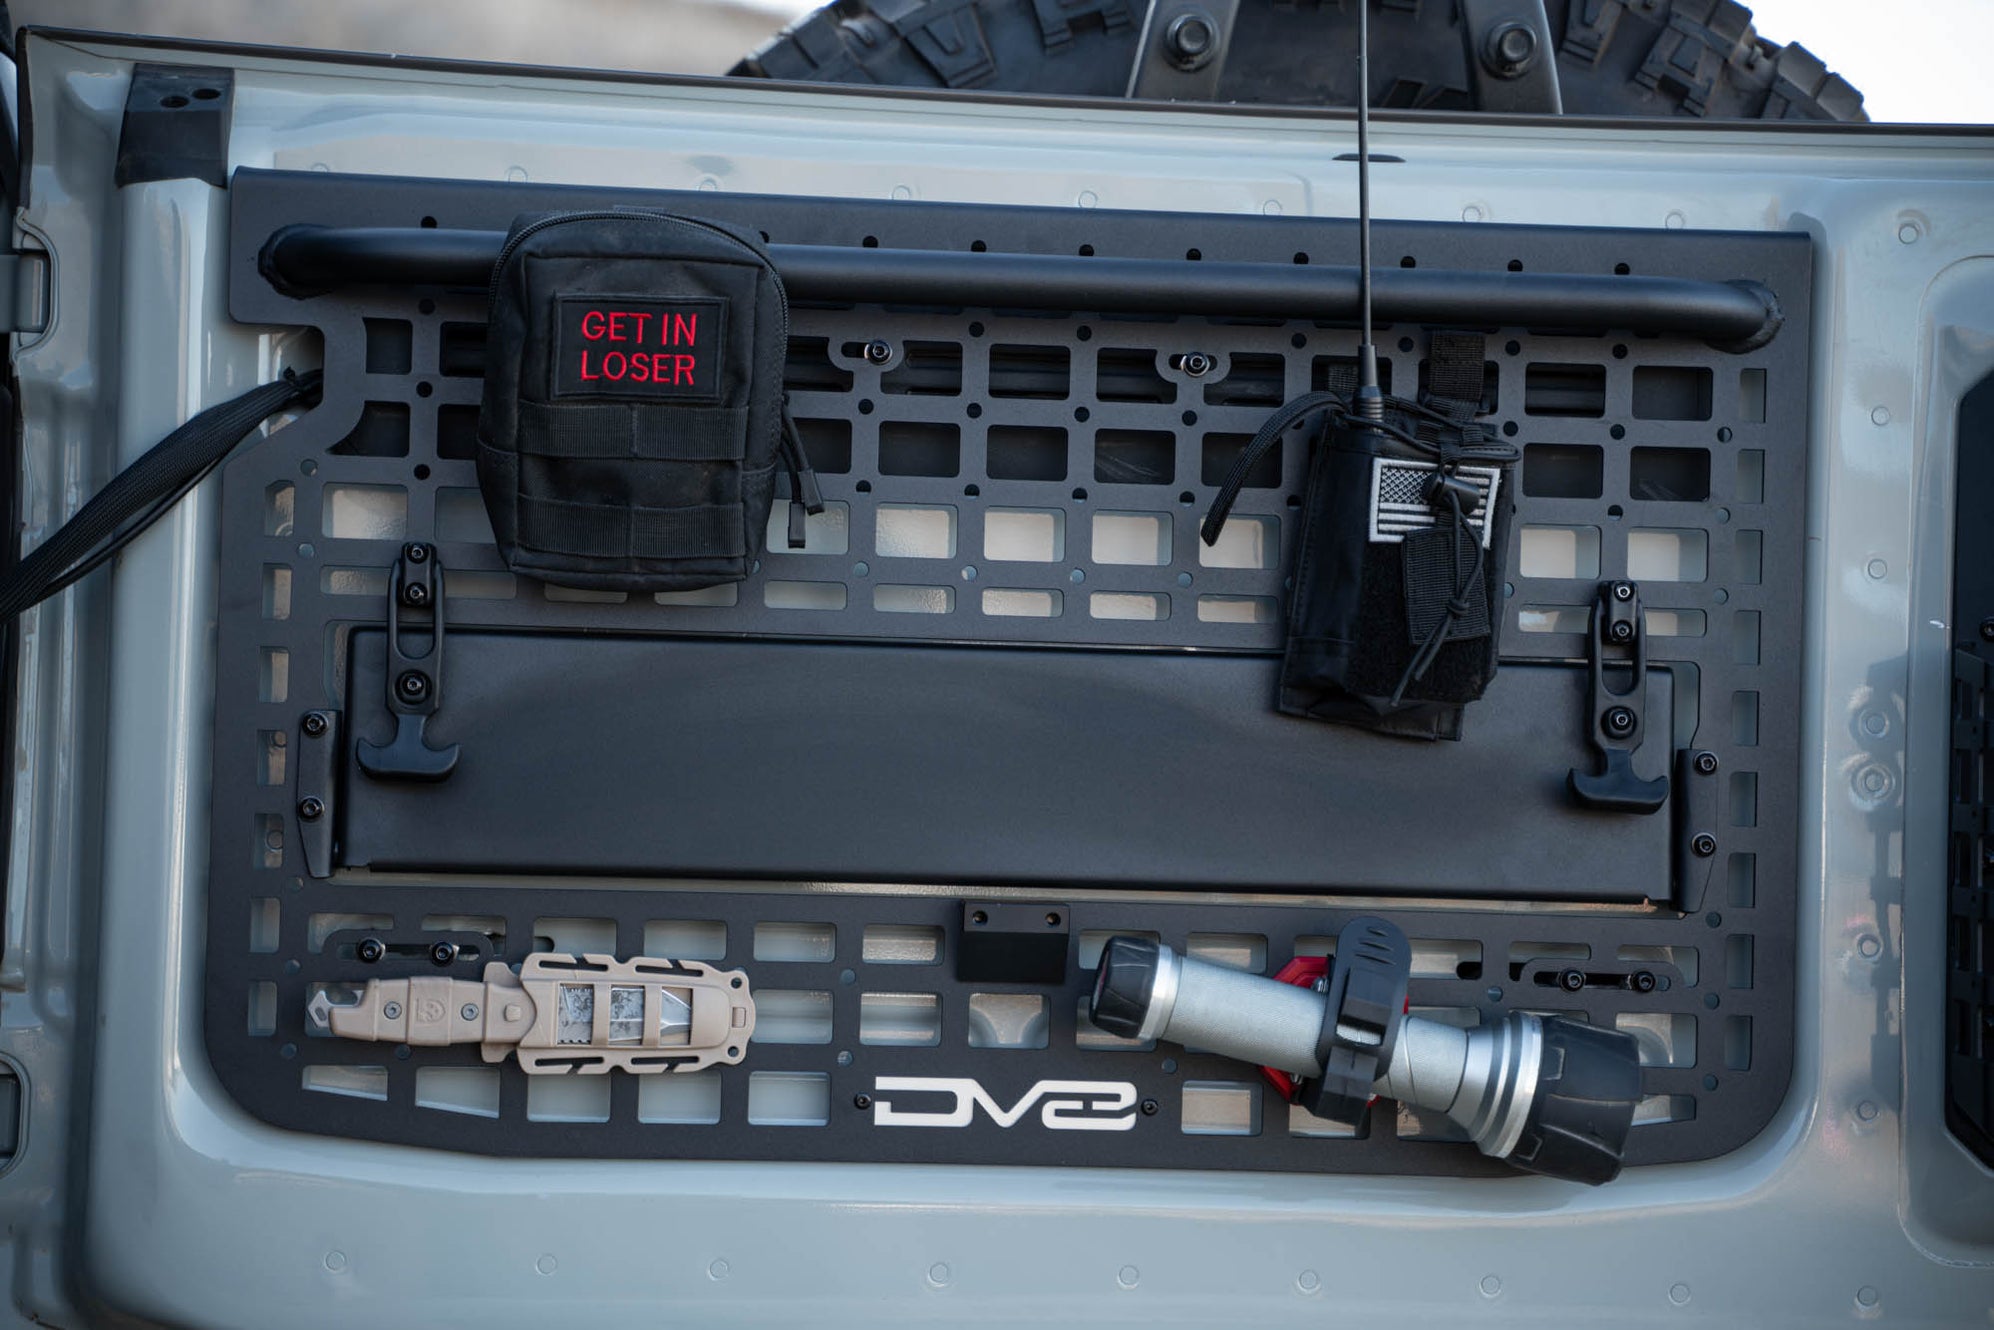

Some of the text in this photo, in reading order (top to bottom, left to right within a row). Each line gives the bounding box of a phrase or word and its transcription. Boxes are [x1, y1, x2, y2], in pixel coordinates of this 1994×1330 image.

[581, 311, 697, 346] GET IN
[580, 350, 696, 385] LOSER
